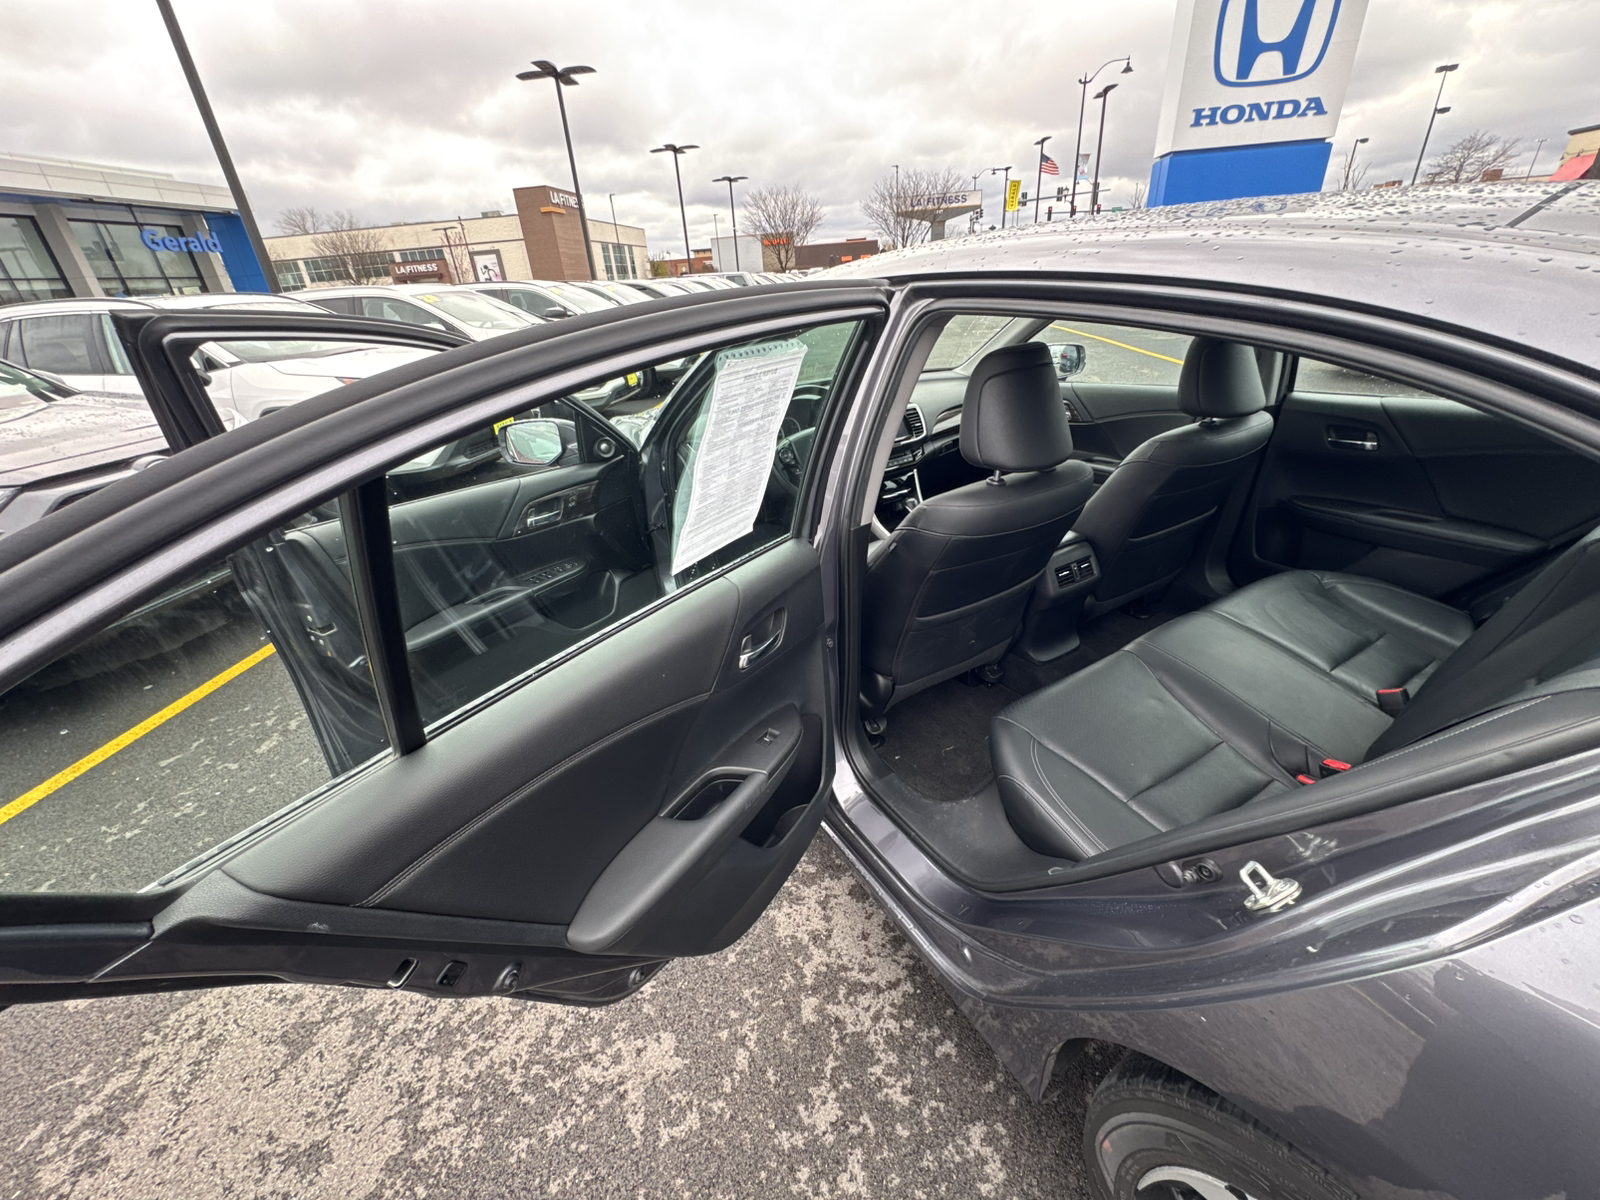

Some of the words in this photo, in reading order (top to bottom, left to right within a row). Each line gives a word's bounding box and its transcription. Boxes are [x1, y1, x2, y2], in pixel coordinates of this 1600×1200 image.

[1190, 96, 1328, 128] HONDA
[550, 190, 560, 205] LA
[910, 198, 922, 208] LA
[927, 194, 967, 206] FITNESS
[141, 227, 223, 253] Gerald
[395, 266, 406, 275] LA
[406, 263, 438, 275] FITNESS
